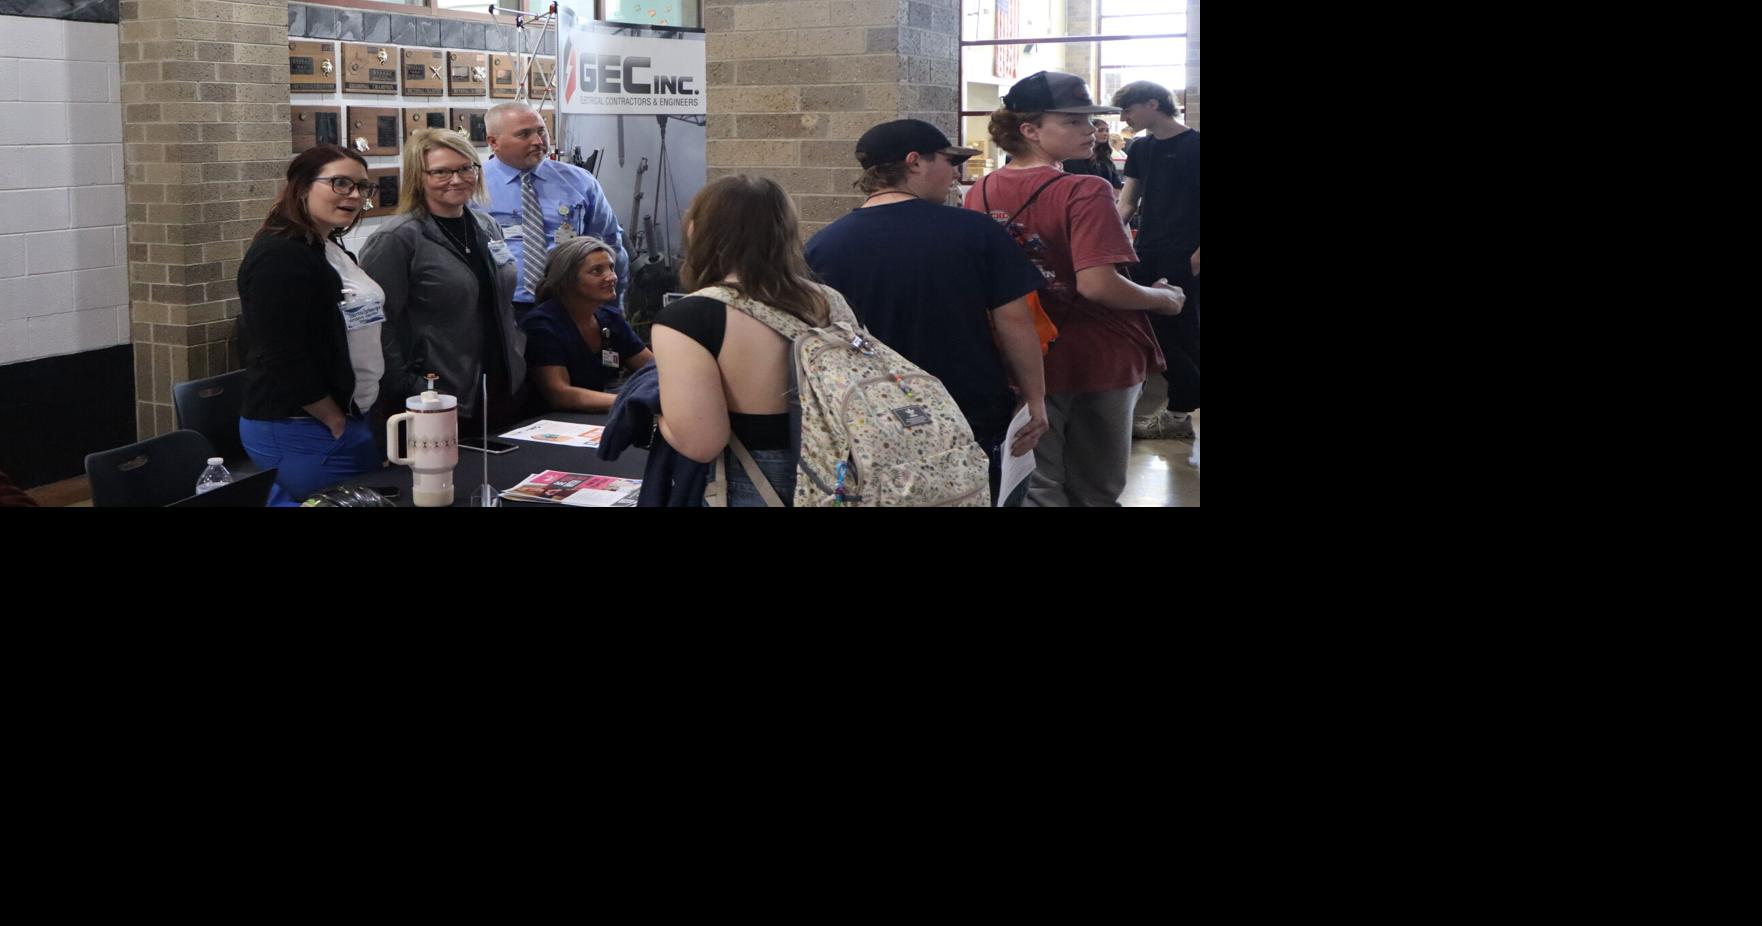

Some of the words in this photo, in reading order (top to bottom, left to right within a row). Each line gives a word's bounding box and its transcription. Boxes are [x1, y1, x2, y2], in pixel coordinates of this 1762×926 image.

[580, 52, 651, 94] GEC
[653, 75, 700, 95] INC.
[605, 97, 649, 106] CONTRACTORS
[652, 98, 658, 106] &
[659, 98, 699, 107] ENGINEERS
